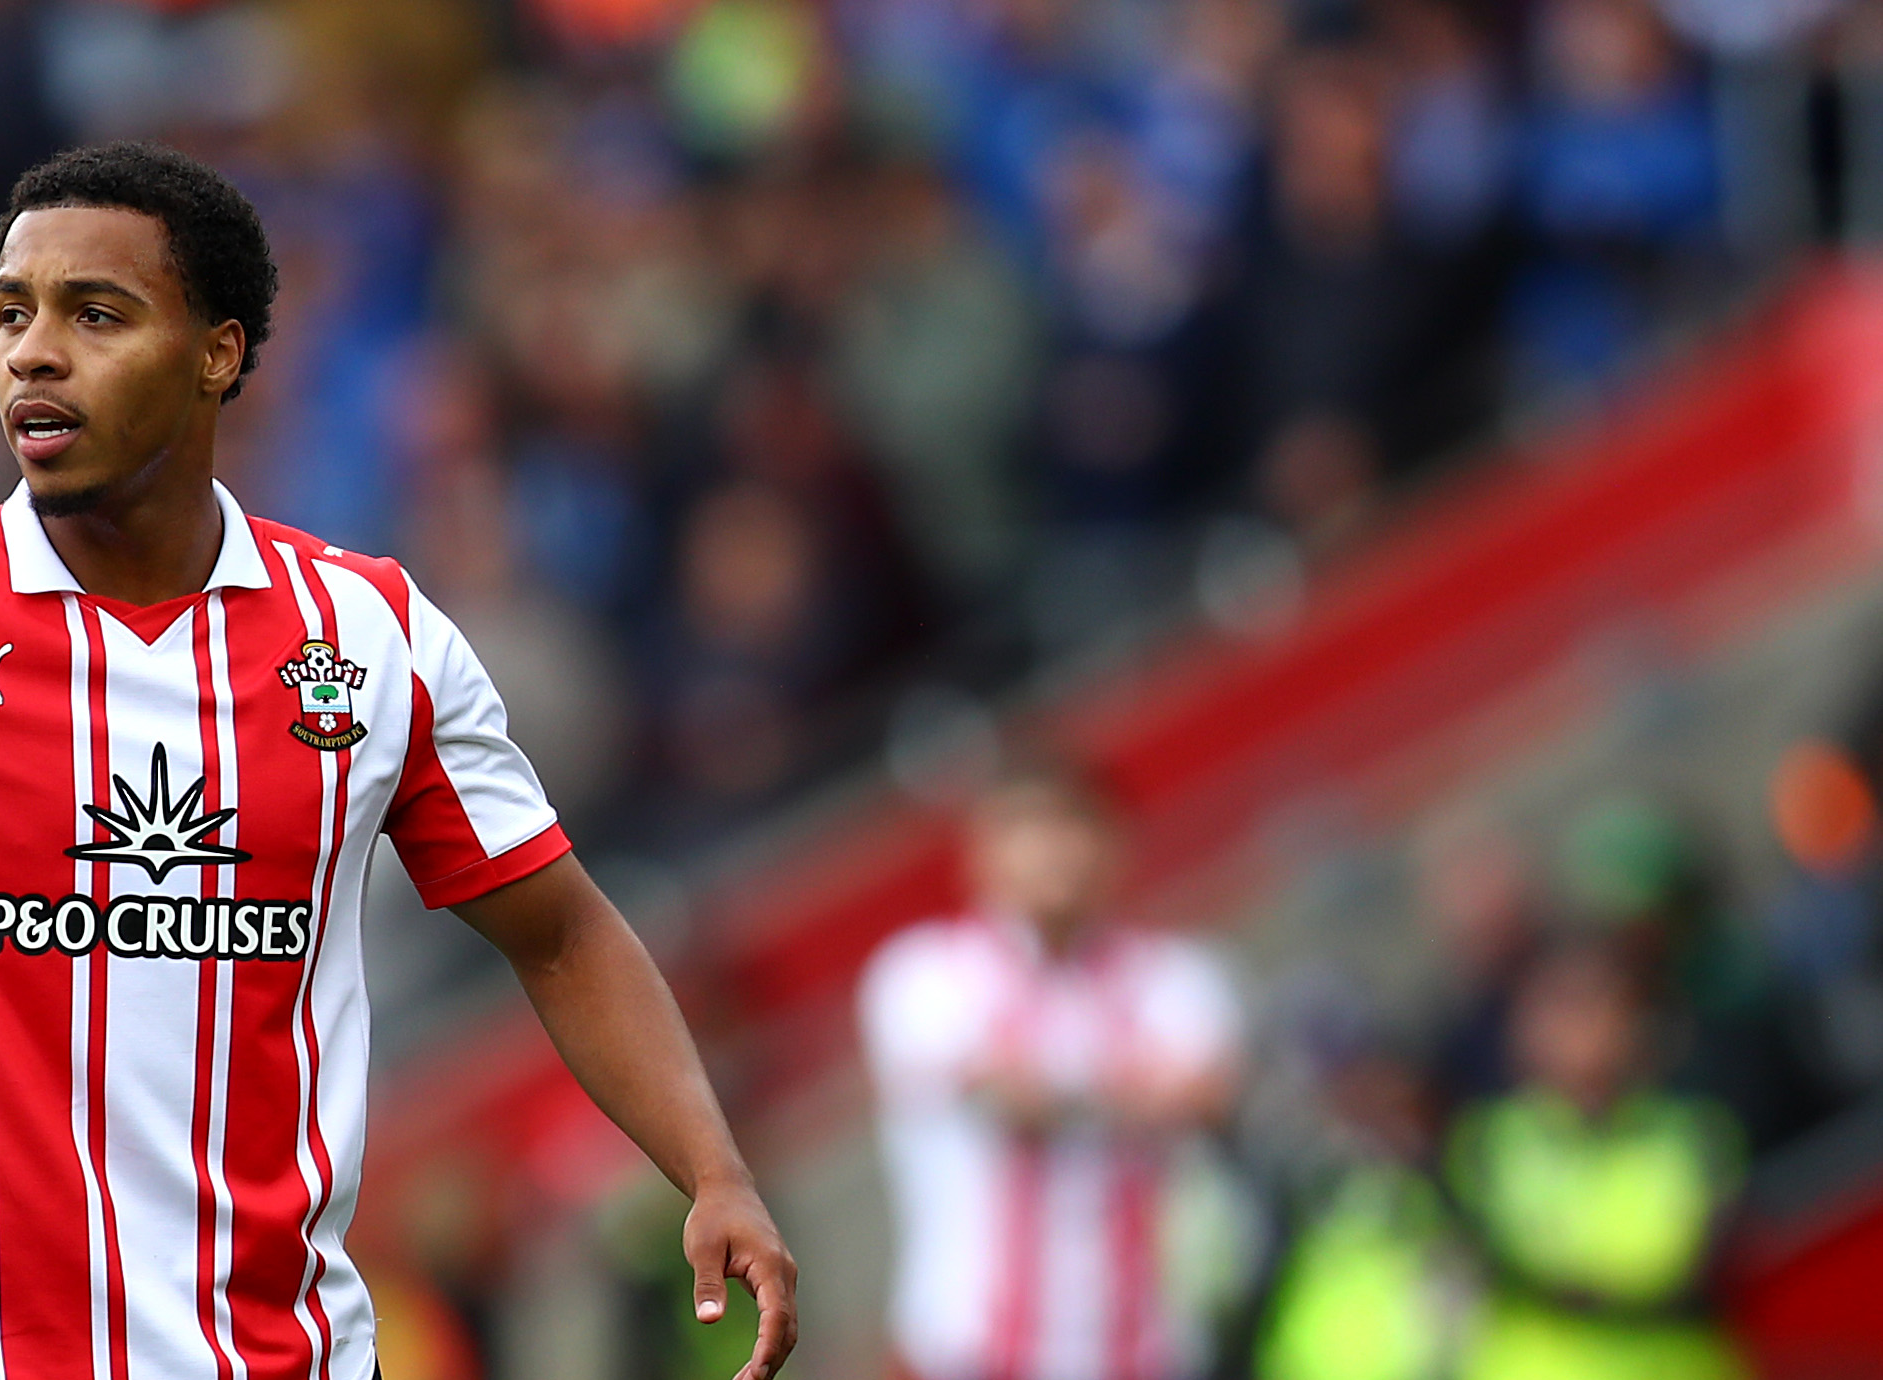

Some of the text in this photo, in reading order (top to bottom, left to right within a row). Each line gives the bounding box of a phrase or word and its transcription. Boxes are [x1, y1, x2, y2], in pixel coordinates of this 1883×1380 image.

[292, 724, 364, 748] SOUTHAMPTON FC
[107, 901, 308, 955] CRUISES
